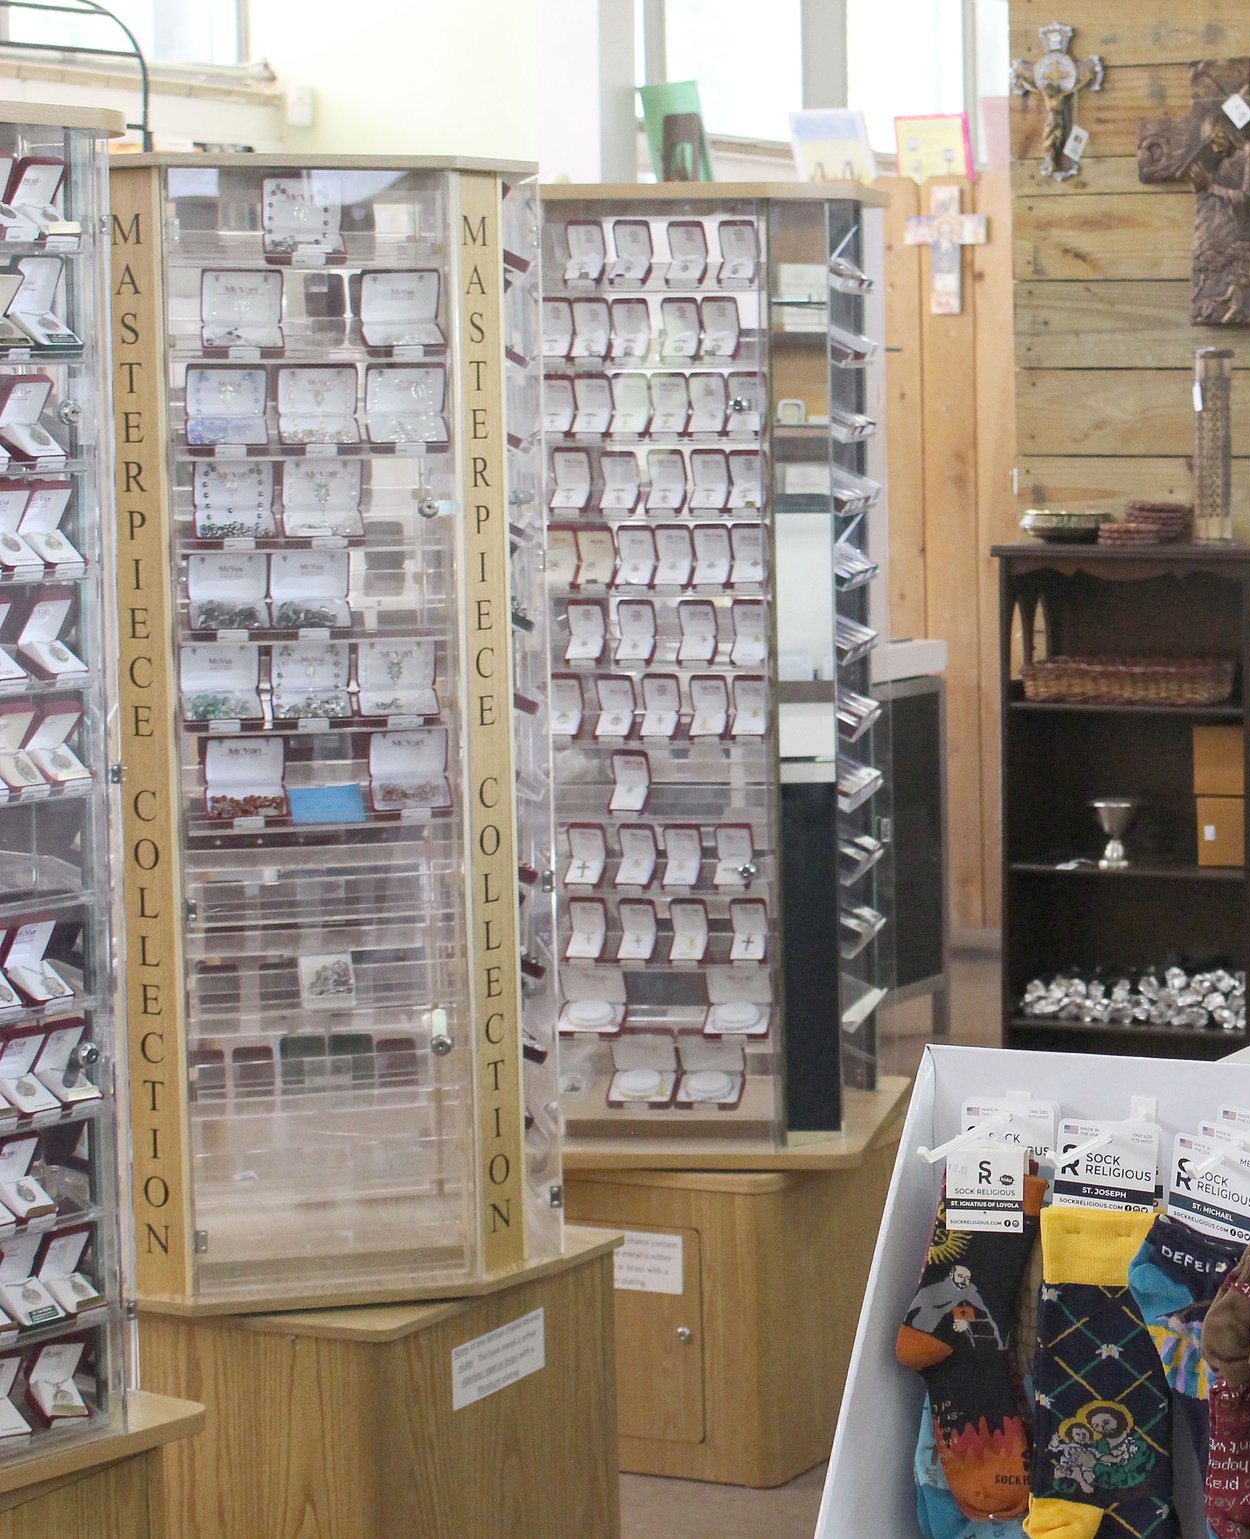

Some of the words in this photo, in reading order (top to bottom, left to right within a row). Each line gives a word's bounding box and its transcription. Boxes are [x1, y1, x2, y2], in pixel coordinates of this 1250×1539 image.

[461, 215, 496, 727] MASTERPIECE
[479, 777, 511, 1233] COLLECTION
[110, 213, 154, 738] MASTERPIECE
[133, 790, 171, 1255] COLLECTION
[1086, 1152, 1121, 1166] SOCK
[1085, 1164, 1152, 1182] RELIGIOUS
[1082, 1186, 1094, 1194] ST.
[1094, 1188, 1127, 1199] JOSEPH
[1059, 1197, 1123, 1210] SOCKRELIGIOUS.COM
[1192, 1202, 1203, 1211] ST.
[1203, 1205, 1234, 1222] MICHAEL
[1173, 1210, 1229, 1233] SOCKRELIGIOUS.COM
